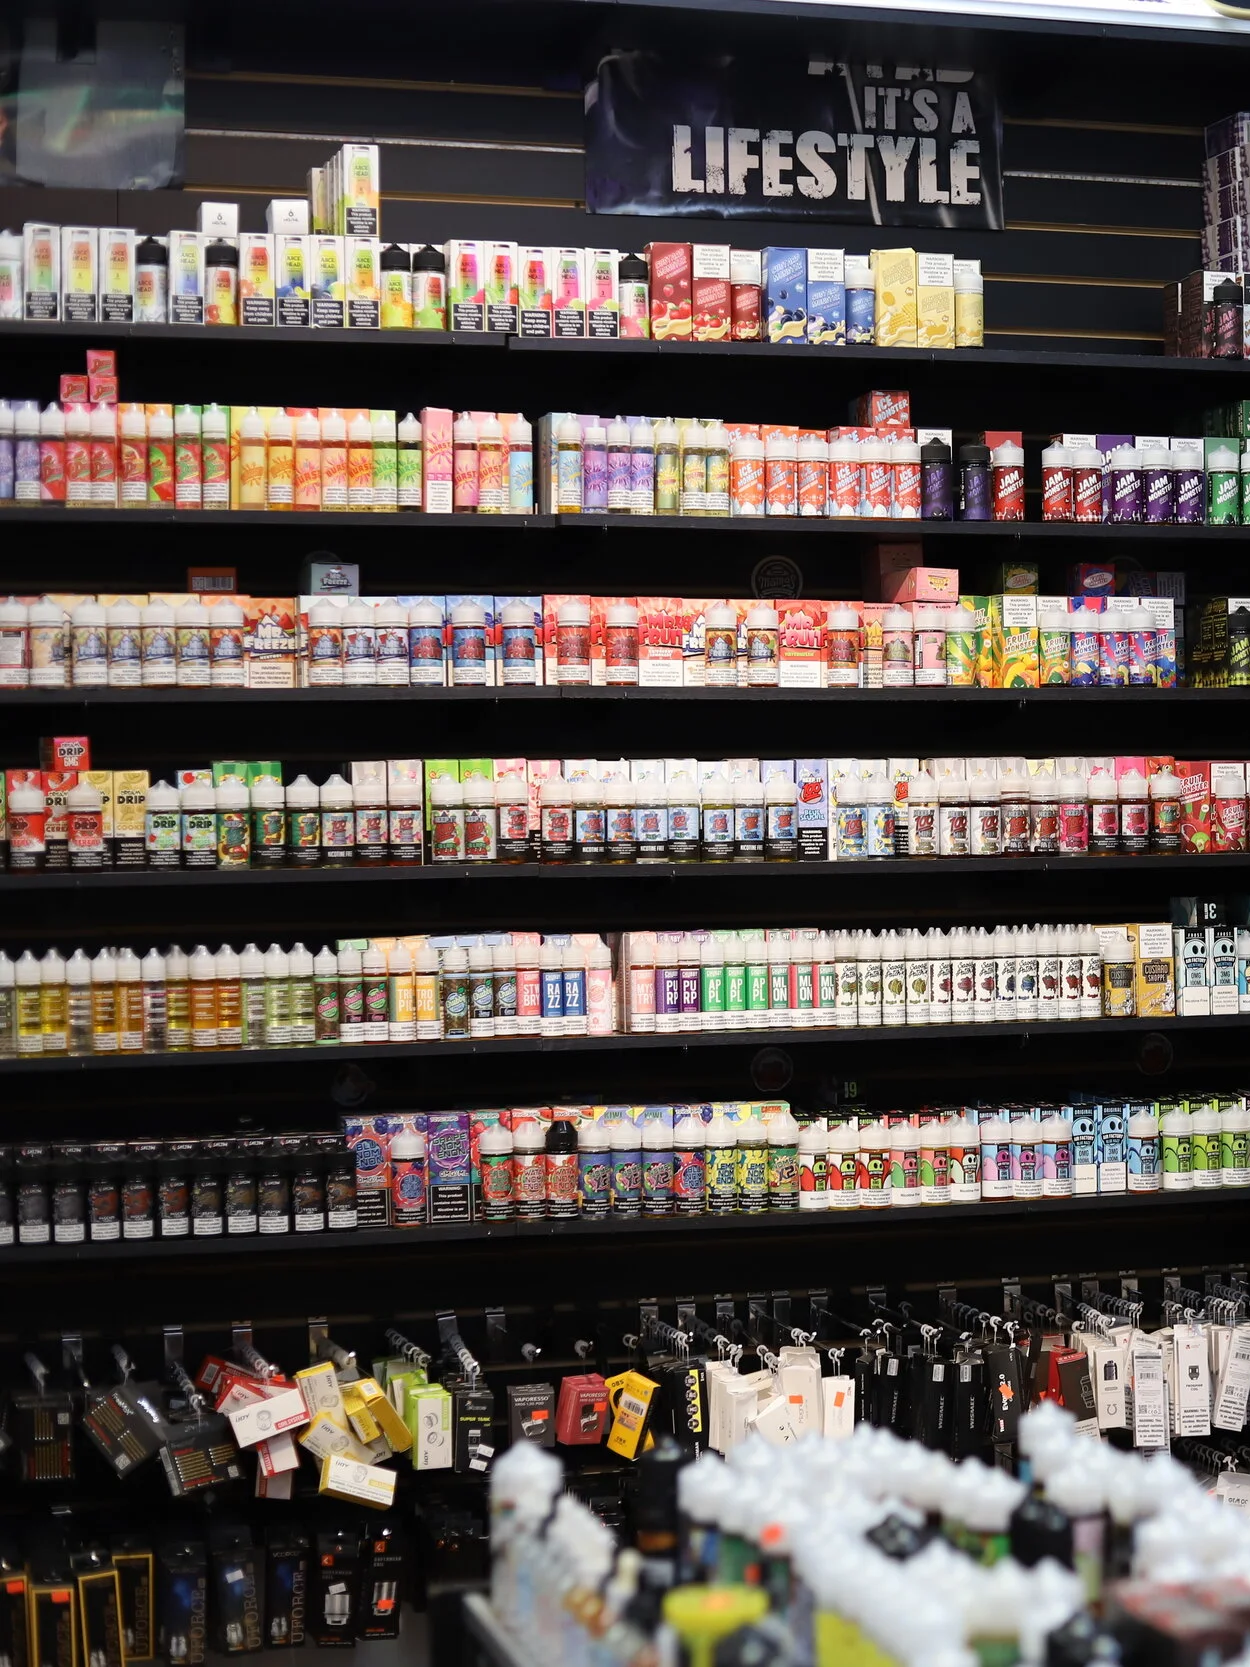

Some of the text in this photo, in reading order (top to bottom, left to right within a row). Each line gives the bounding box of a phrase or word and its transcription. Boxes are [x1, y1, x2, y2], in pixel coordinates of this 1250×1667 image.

[864, 86, 976, 135] IT'S A
[672, 125, 982, 206] LIFESTYLE
[876, 395, 892, 411] ICE
[875, 399, 908, 423] MONSTER
[427, 441, 453, 454] BURST
[739, 467, 754, 478] ICE
[837, 466, 850, 478] ICE
[871, 465, 884, 478] ICE
[900, 465, 913, 478] ICE
[1000, 471, 1020, 488] JAM
[1045, 472, 1063, 490] JAM
[1078, 475, 1097, 493] JAM
[1116, 472, 1136, 491] JAM
[1149, 476, 1168, 493] JAM
[1180, 477, 1199, 494] JAM
[1218, 477, 1236, 495] JAM
[998, 478, 1025, 500] MONSTER
[1044, 477, 1070, 500] MONSTER
[1076, 481, 1102, 503] MONSTER
[1115, 480, 1141, 501] MONSTER
[1148, 482, 1172, 502] MONSTER
[322, 577, 348, 585] FREEZE
[649, 613, 676, 628] MR.
[785, 611, 815, 630] MR.
[640, 626, 683, 646] FRUIT
[779, 628, 822, 648] FRUIT
[1006, 632, 1030, 645] FRUIT
[1045, 635, 1065, 648] FRUIT
[1075, 636, 1097, 649] FRUIT
[244, 635, 295, 651] FREEZE
[1003, 639, 1037, 653] MONSTER
[58, 747, 84, 757] DRIP
[64, 757, 79, 767] 6MG
[802, 782, 822, 796] 100
[45, 797, 67, 806] DRI
[117, 795, 145, 805] DRIP
[1222, 804, 1243, 816] FRUIT
[74, 821, 98, 830] DRIP
[153, 820, 176, 828] DRIP
[189, 820, 213, 829] DRIP
[915, 815, 934, 832] 100
[950, 816, 967, 833] 100
[980, 815, 999, 833] 100
[1145, 965, 1169, 974] CUSTARD
[565, 982, 579, 993] RA
[666, 980, 678, 991] PU
[683, 980, 696, 991] PU
[708, 978, 721, 989] AP
[731, 978, 743, 989] AP
[753, 977, 765, 989] AP
[772, 976, 786, 987] ML
[800, 976, 812, 987] ML
[821, 975, 834, 987] ML
[417, 989, 433, 999] TRO
[547, 985, 561, 996] RA
[708, 990, 721, 1003] PL
[730, 990, 743, 1003] PL
[753, 989, 765, 1002] PL
[773, 988, 787, 1002] ON
[800, 987, 812, 1001] ON
[821, 987, 834, 1000] ON
[547, 995, 561, 1009] ZZ
[566, 993, 579, 1006] ZZ
[667, 992, 679, 1005] RP
[683, 991, 697, 1004] RP
[417, 999, 433, 1011] PIC
[432, 1133, 467, 1144] GRAPE
[439, 1142, 463, 1151] NOM
[437, 1150, 467, 1159] ENON
[716, 1162, 736, 1170] LEMO
[746, 1162, 766, 1170] LEMO
[717, 1170, 736, 1178] NOM
[716, 1177, 737, 1185] ENON
